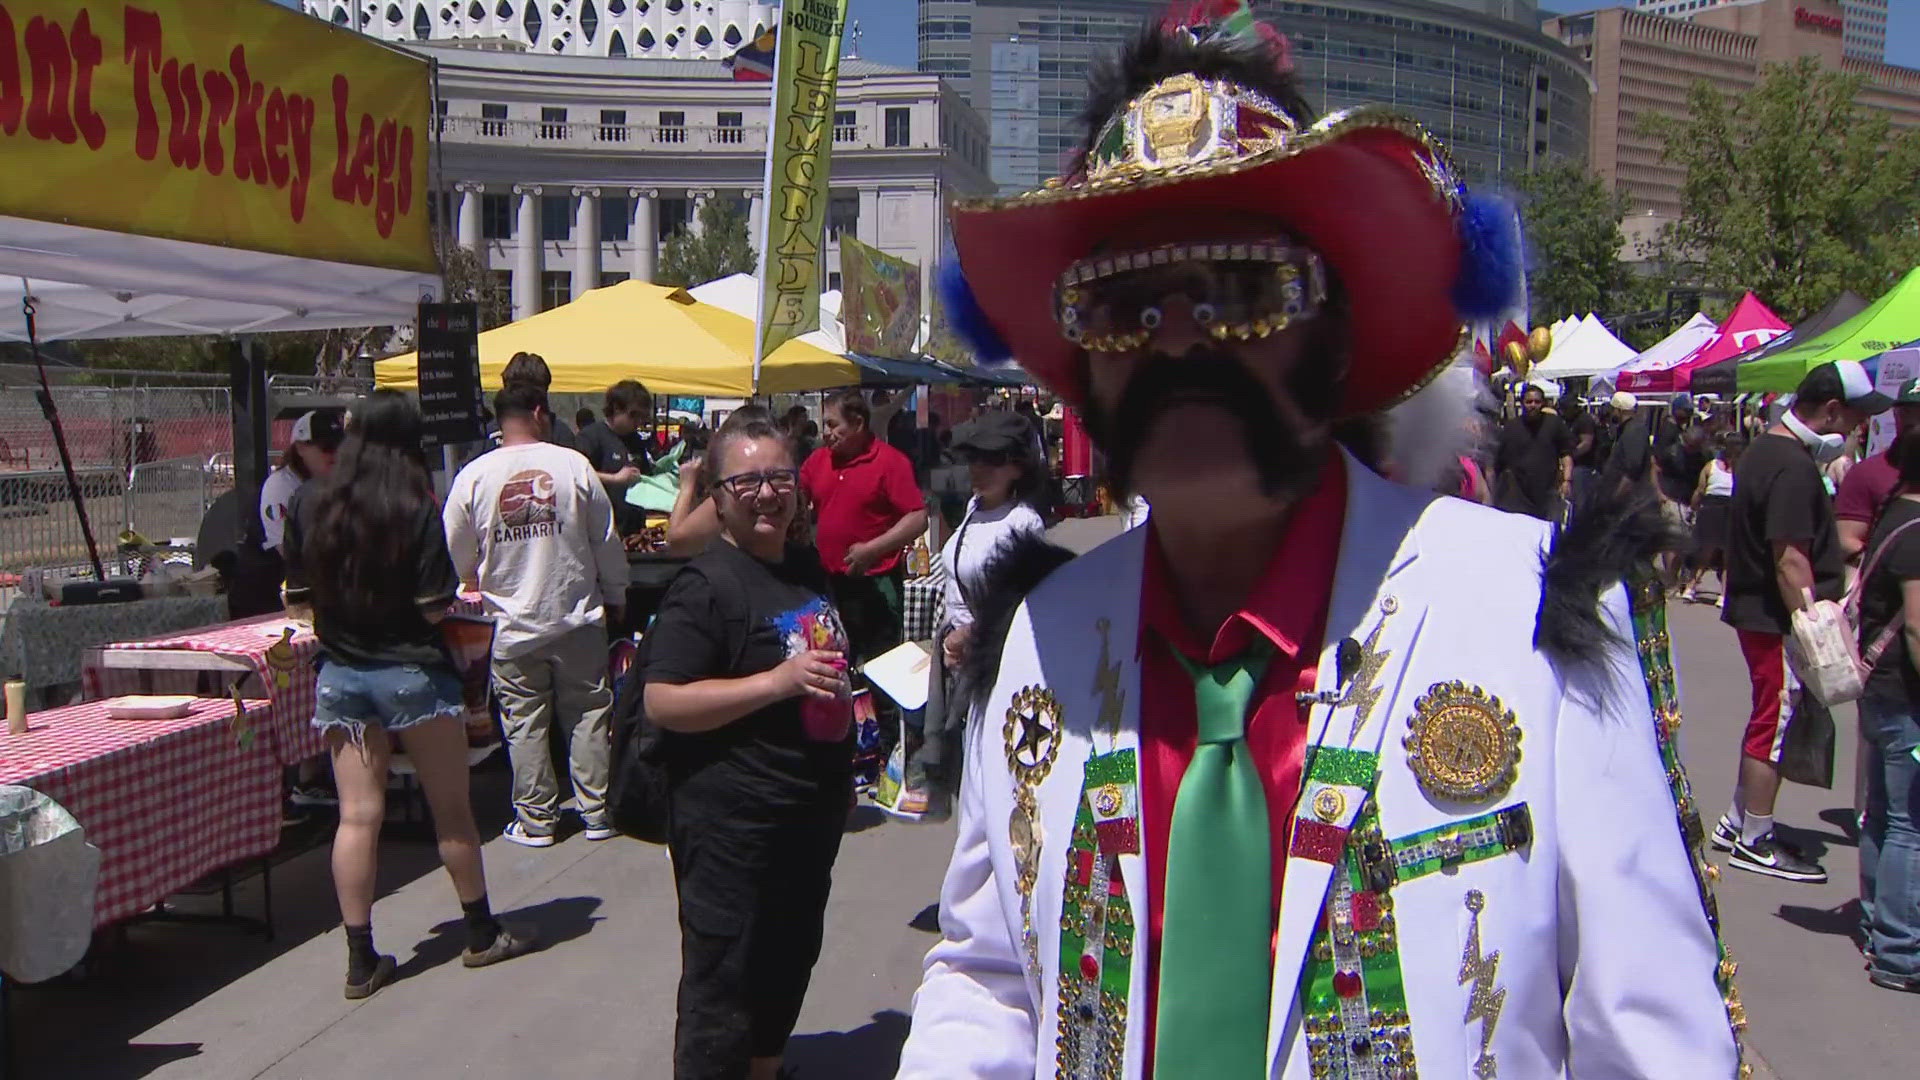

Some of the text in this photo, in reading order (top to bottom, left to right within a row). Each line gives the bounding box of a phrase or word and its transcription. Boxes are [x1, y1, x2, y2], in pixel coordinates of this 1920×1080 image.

[124, 5, 315, 224] Turkey
[331, 74, 414, 239] Legs
[770, 40, 836, 327] LEMONADE
